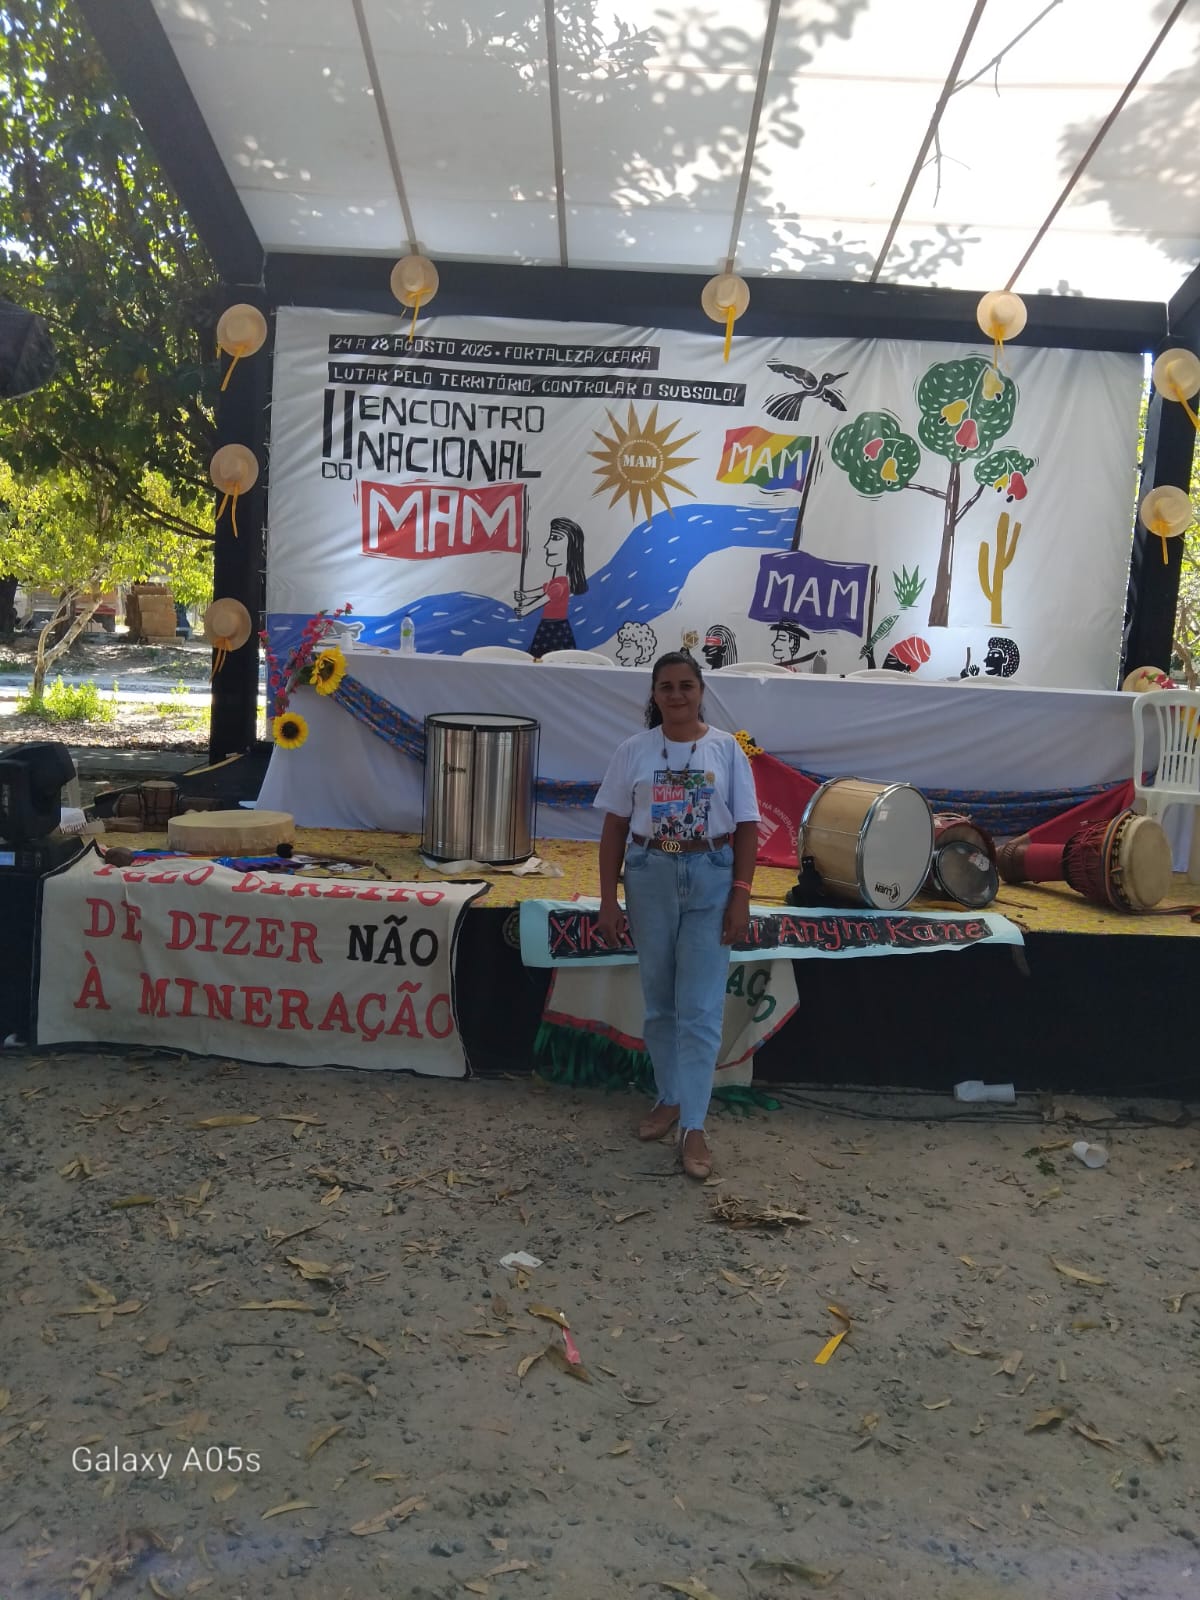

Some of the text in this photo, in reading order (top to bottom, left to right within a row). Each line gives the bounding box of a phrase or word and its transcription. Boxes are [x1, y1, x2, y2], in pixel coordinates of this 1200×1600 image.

[333, 337, 352, 349] 24
[355, 337, 367, 349] A
[371, 337, 390, 351] 28
[394, 338, 456, 355] AGOSTO
[333, 367, 738, 403] LUTAR PELO TERRITÓRIO, CONTROLAR O SUBSOLO!
[358, 395, 545, 433] ENCONTRO
[321, 461, 353, 480] DO
[357, 430, 542, 482] NACIONAL
[623, 454, 658, 468] MAM
[728, 442, 804, 481] MAM
[369, 487, 518, 553] MAM
[763, 570, 859, 620] MAM
[84, 898, 440, 967] DE DIZER NÃO
[779, 915, 879, 951] Anym
[885, 917, 984, 942] Kane
[74, 951, 455, 1042] À MINERAÇÃO
